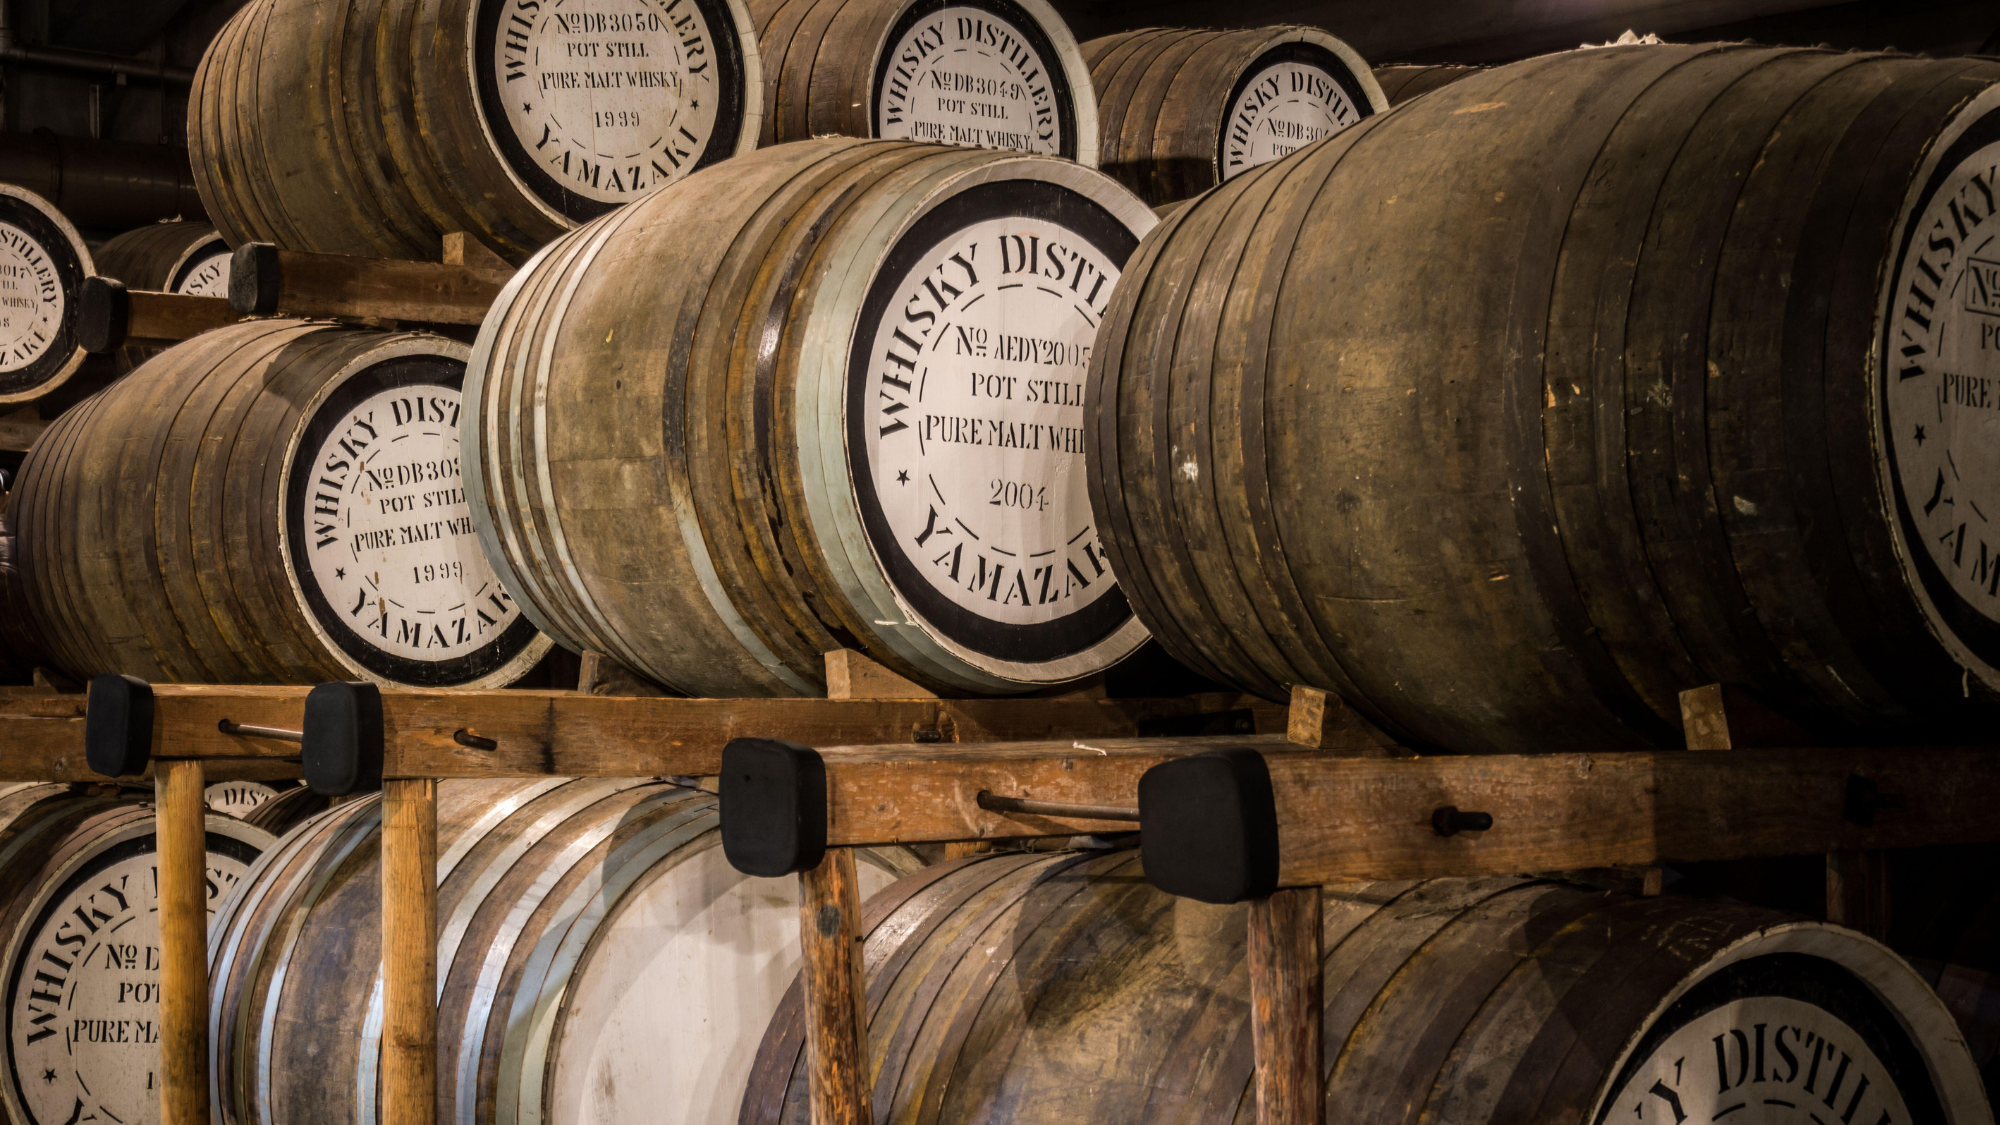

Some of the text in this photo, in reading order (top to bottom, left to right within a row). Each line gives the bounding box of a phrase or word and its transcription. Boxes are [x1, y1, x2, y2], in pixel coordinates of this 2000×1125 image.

[567, 43, 649, 58] POT STILL
[542, 71, 679, 89] PURE MALT WHISKY
[887, 17, 1054, 149] WHISKY DISTILLERY
[595, 111, 640, 128] 1999
[938, 97, 1008, 119] POT STILL
[1230, 71, 1354, 167] WHISKY DISTIL
[914, 121, 1031, 151] PURE MALT WHISKY
[536, 123, 698, 192] YAMAZAKI
[1900, 165, 1997, 382] WHISKY
[2, 296, 35, 309] WHISKY
[879, 234, 1108, 439] WHISKY DISTI
[971, 372, 1017, 400] POT
[1942, 372, 1992, 409] PURE
[925, 415, 982, 444] PURE
[987, 420, 1044, 450] MALT
[314, 411, 379, 550] WHISKY
[989, 478, 1049, 512] 2004
[380, 495, 415, 514] POT
[354, 529, 395, 552] PURE
[400, 522, 444, 545] MALT
[413, 561, 463, 584] 1999
[27, 875, 130, 1047] WHISKY
[73, 1020, 130, 1043] PURE
[1712, 1023, 1893, 1125] DISTIL
